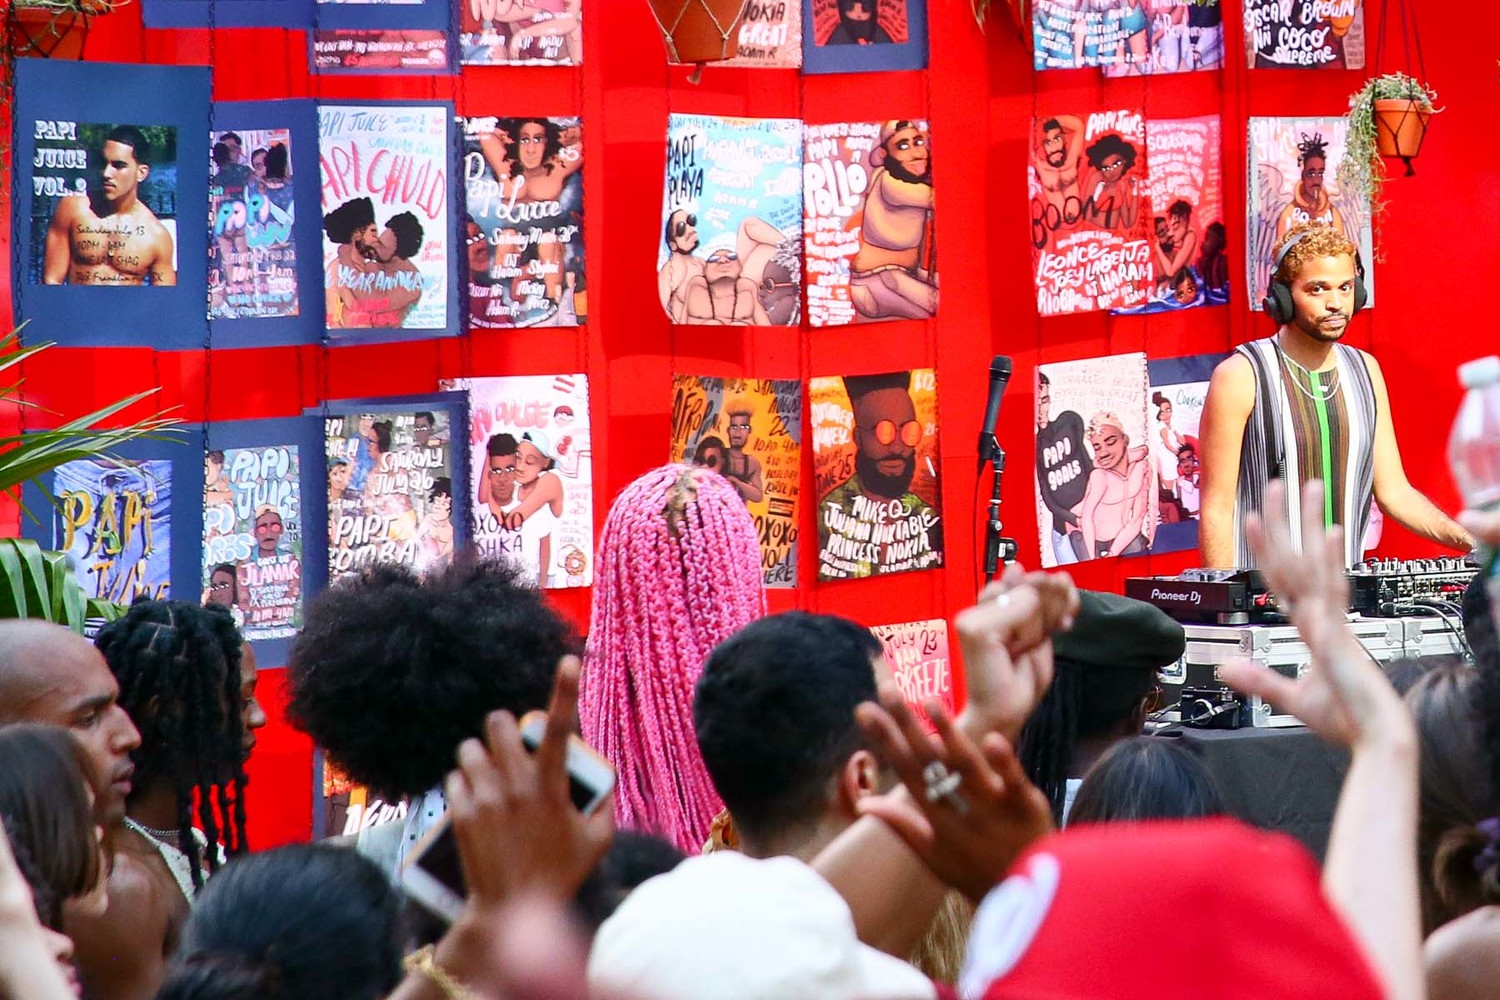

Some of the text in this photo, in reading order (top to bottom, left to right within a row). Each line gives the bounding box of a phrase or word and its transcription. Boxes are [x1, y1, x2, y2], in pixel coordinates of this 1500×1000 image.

[1244, 0, 1292, 33] OSCAR
[736, 24, 788, 47] GREAT
[1278, 26, 1331, 52] COCO
[1259, 45, 1337, 66] SUPREME
[34, 120, 76, 140] PAPI
[319, 111, 346, 137] API
[1085, 111, 1116, 141] PAPI
[33, 148, 87, 169] JUICE
[667, 133, 698, 176] PAPI
[32, 176, 73, 197] VOL.
[319, 140, 447, 220] API CHULO
[669, 167, 704, 213] PLAYA
[803, 158, 868, 218] POLLO
[497, 174, 562, 224] Luxxe
[136, 226, 145, 236] 13
[1032, 194, 1116, 250] BOOM
[1036, 243, 1110, 287] LEONCE
[1085, 239, 1151, 281] LABEIJA
[337, 263, 375, 294] YEAR
[1099, 262, 1154, 293] HARAM
[231, 448, 291, 484] PAPI
[380, 447, 445, 474] SATURDAY
[1042, 436, 1073, 469] PAPI
[372, 472, 409, 497] JULY
[1047, 459, 1083, 492] GOALS
[237, 480, 301, 521] JUICE
[60, 488, 157, 557] PAPI
[334, 514, 391, 547] PAPI
[870, 507, 941, 546] HUXTABLE
[827, 531, 932, 565] PRINCESS NOKIA
[239, 562, 301, 587] JLAMAR
[1151, 588, 1189, 601] Pioneer
[885, 629, 938, 660] JULY 23
[895, 646, 923, 670] PAPI
